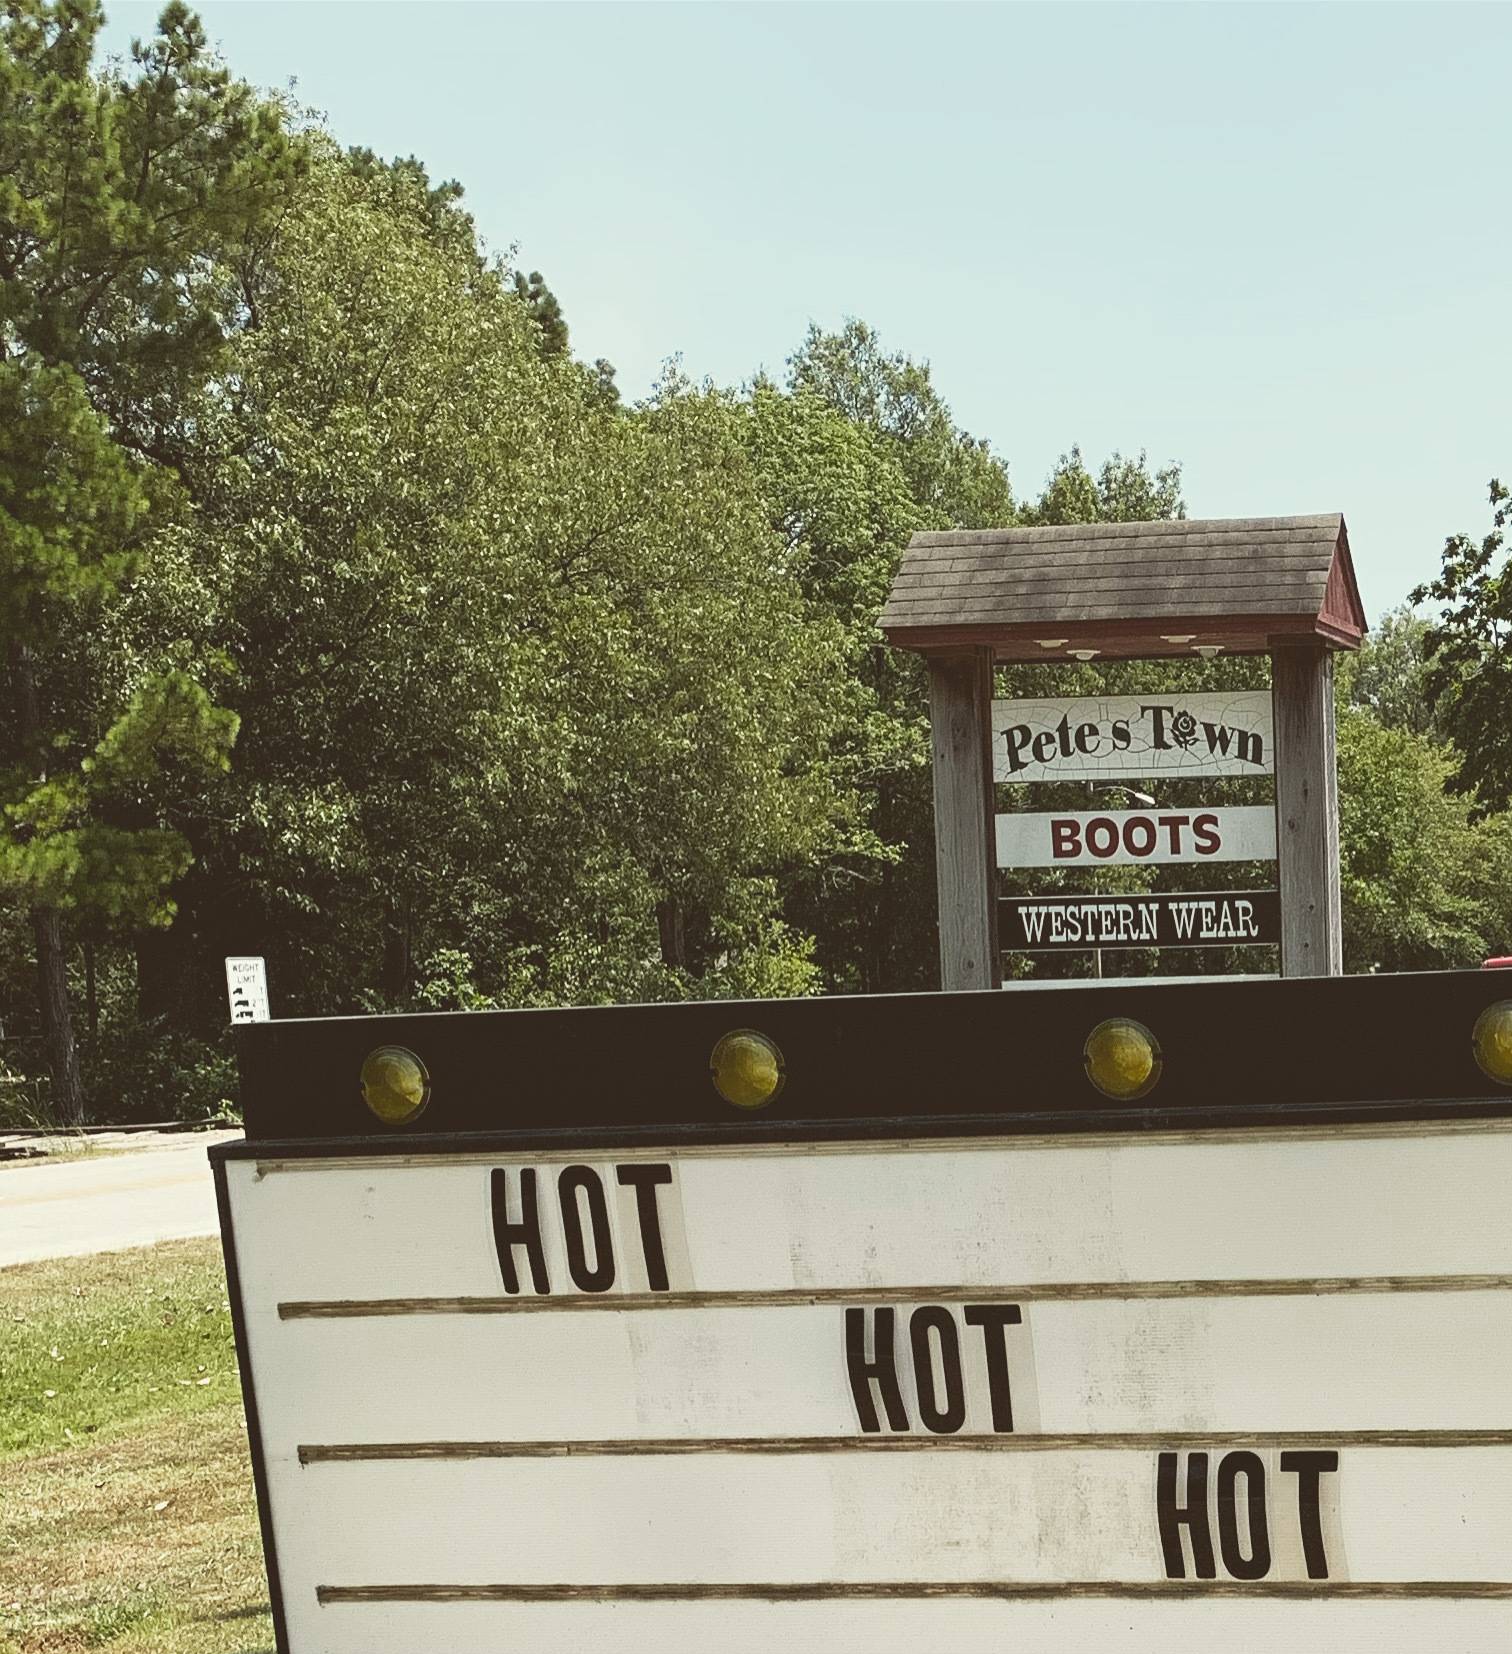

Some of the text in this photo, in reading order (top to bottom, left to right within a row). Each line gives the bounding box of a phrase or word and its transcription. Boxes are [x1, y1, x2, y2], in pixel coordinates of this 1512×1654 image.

[1050, 813, 1222, 860] BOOTS
[1018, 899, 1259, 944] WESTERN WEAR
[490, 1163, 673, 1295] HOT
[845, 1304, 1022, 1435] HOT
[1156, 1450, 1340, 1581] HOT
